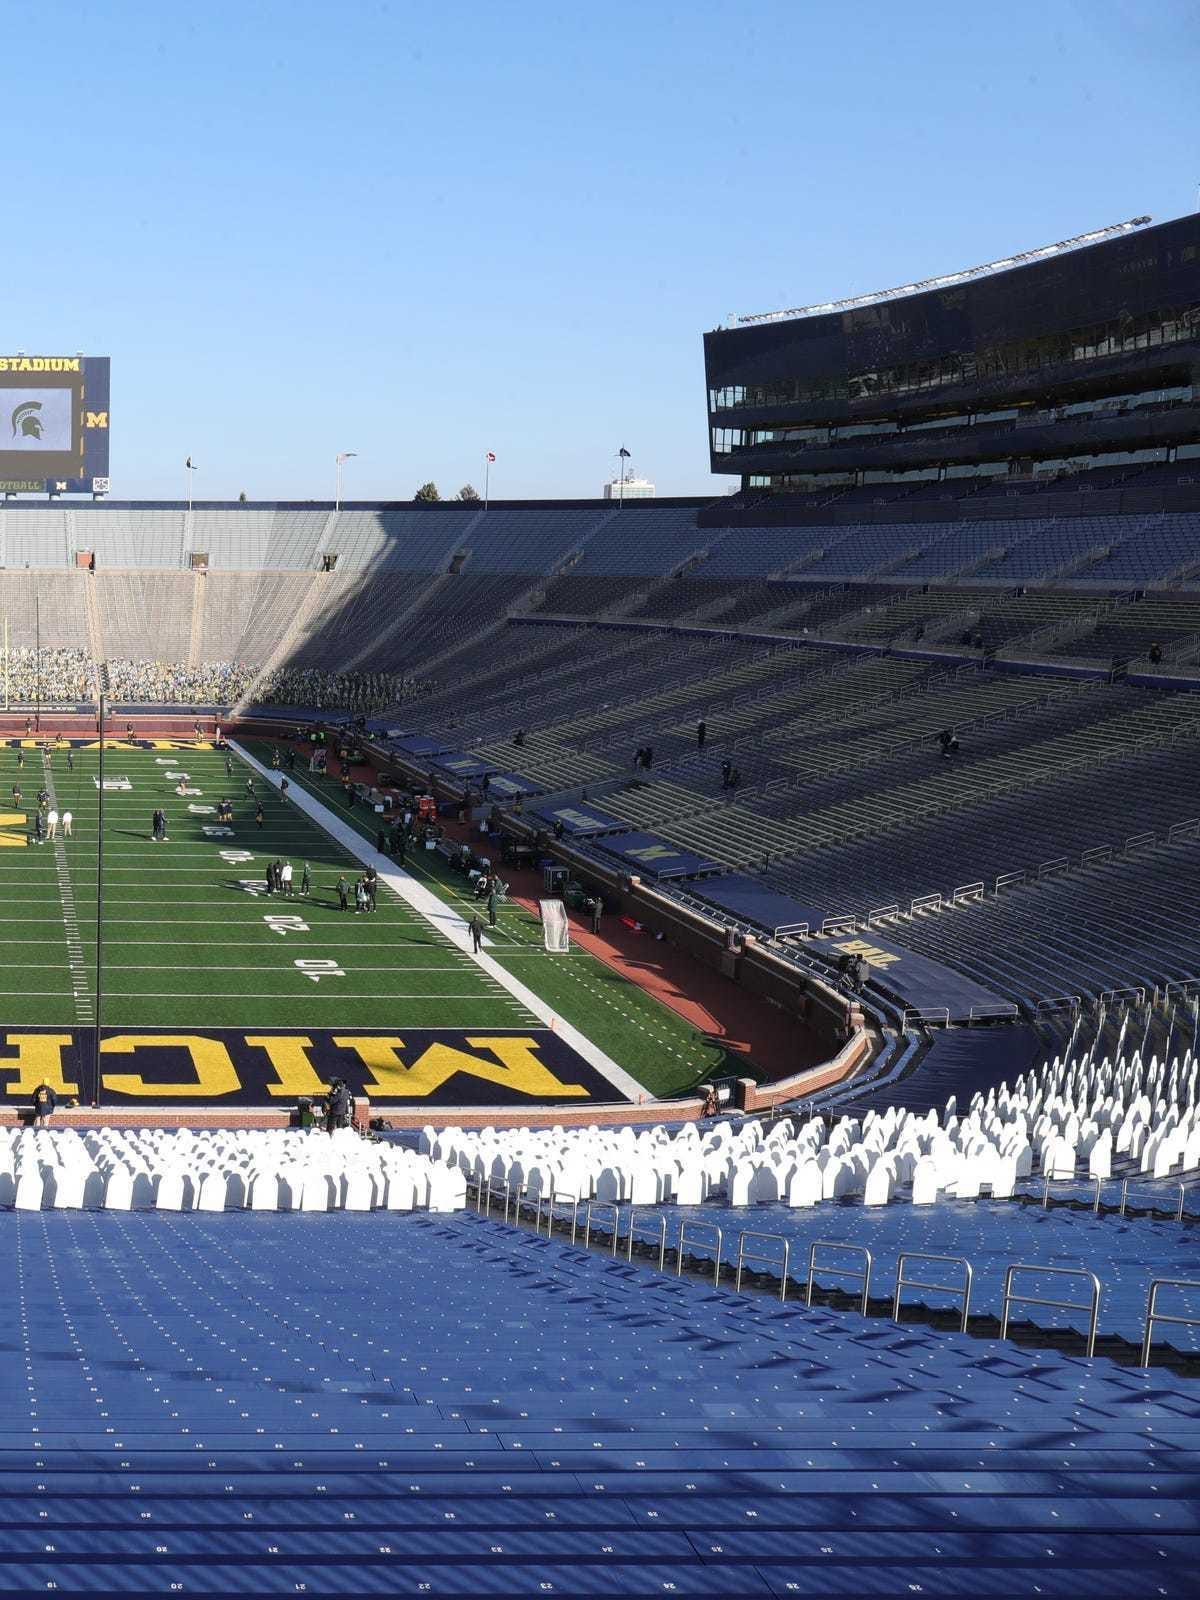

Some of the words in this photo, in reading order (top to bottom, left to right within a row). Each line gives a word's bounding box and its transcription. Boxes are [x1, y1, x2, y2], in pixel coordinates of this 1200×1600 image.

[86, 412, 108, 428] M
[56, 481, 67, 490] M
[263, 915, 311, 932] 20
[294, 959, 346, 977] 10
